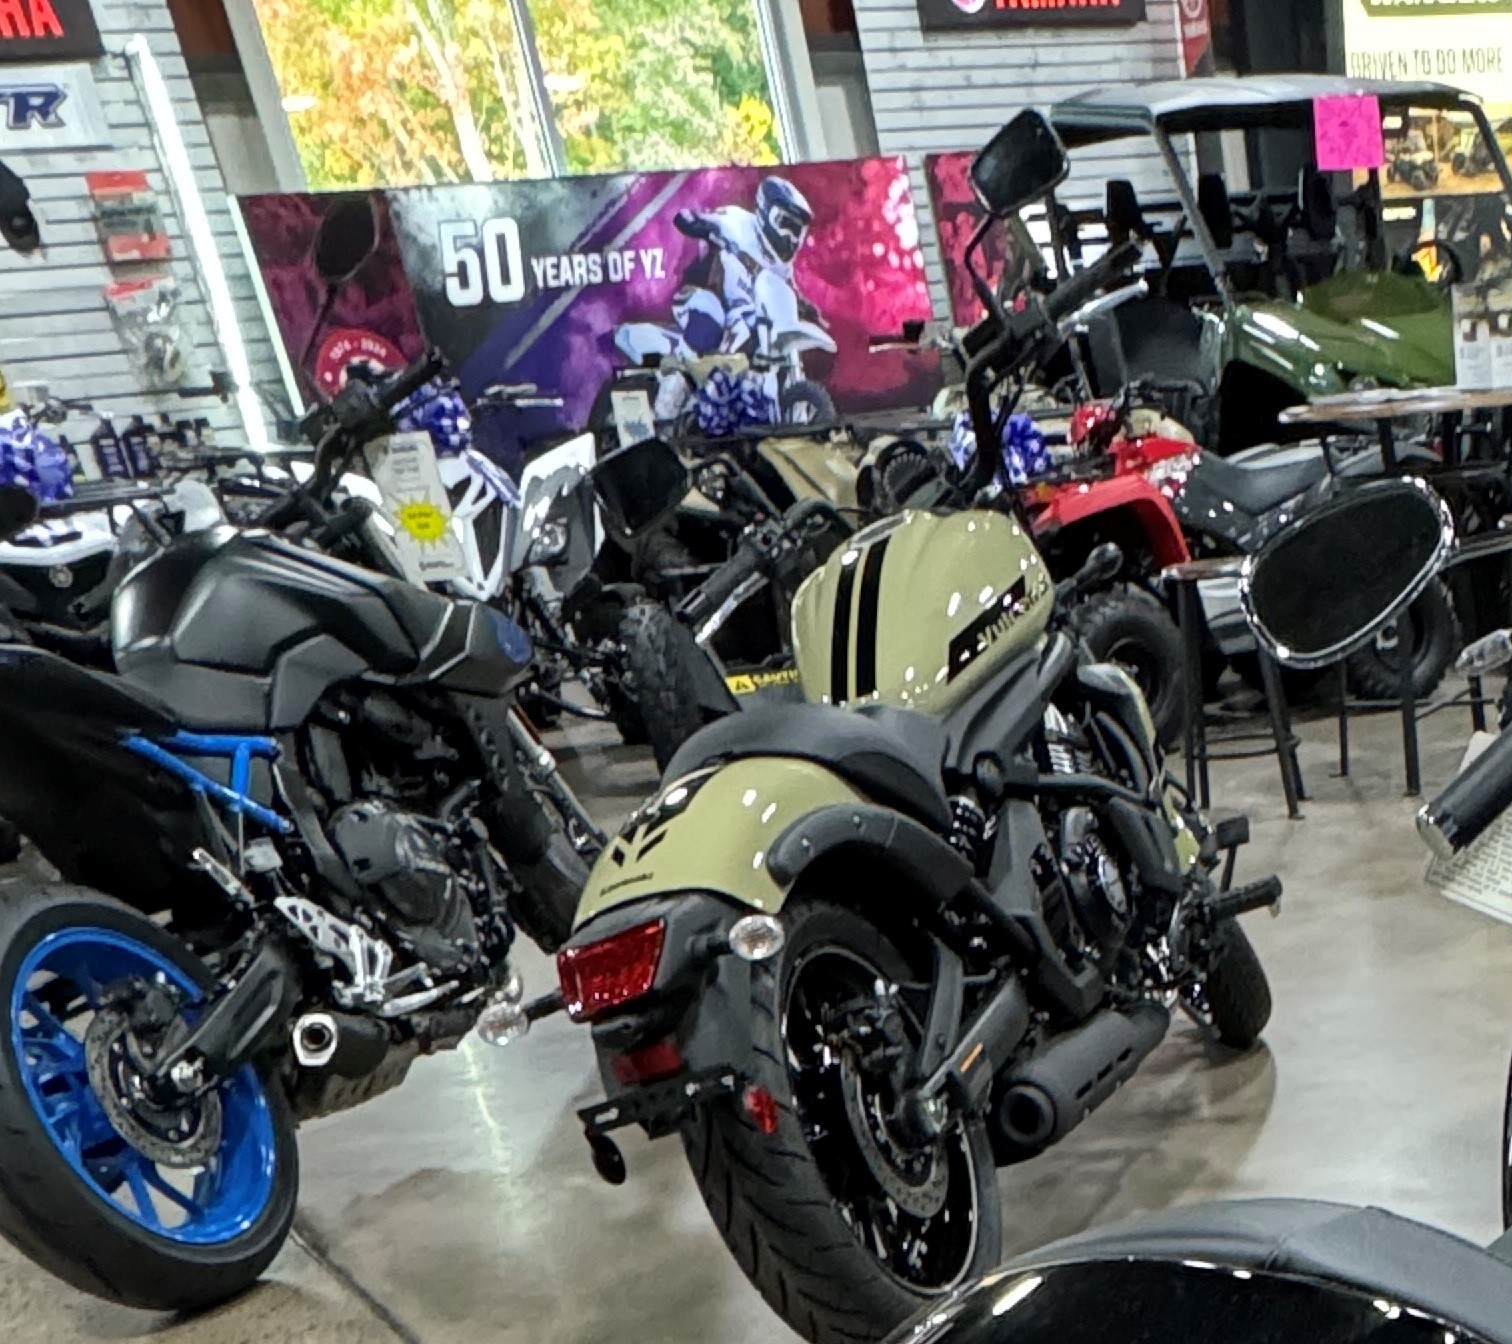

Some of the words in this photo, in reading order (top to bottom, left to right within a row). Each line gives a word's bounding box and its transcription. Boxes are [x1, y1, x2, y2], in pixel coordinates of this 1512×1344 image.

[1414, 49, 1432, 75] TO
[1437, 49, 1456, 75] DO
[1463, 47, 1503, 74] MORE
[438, 217, 526, 307] 50
[531, 253, 603, 289] YEARS
[607, 250, 636, 283] OF
[639, 248, 666, 279] YZ
